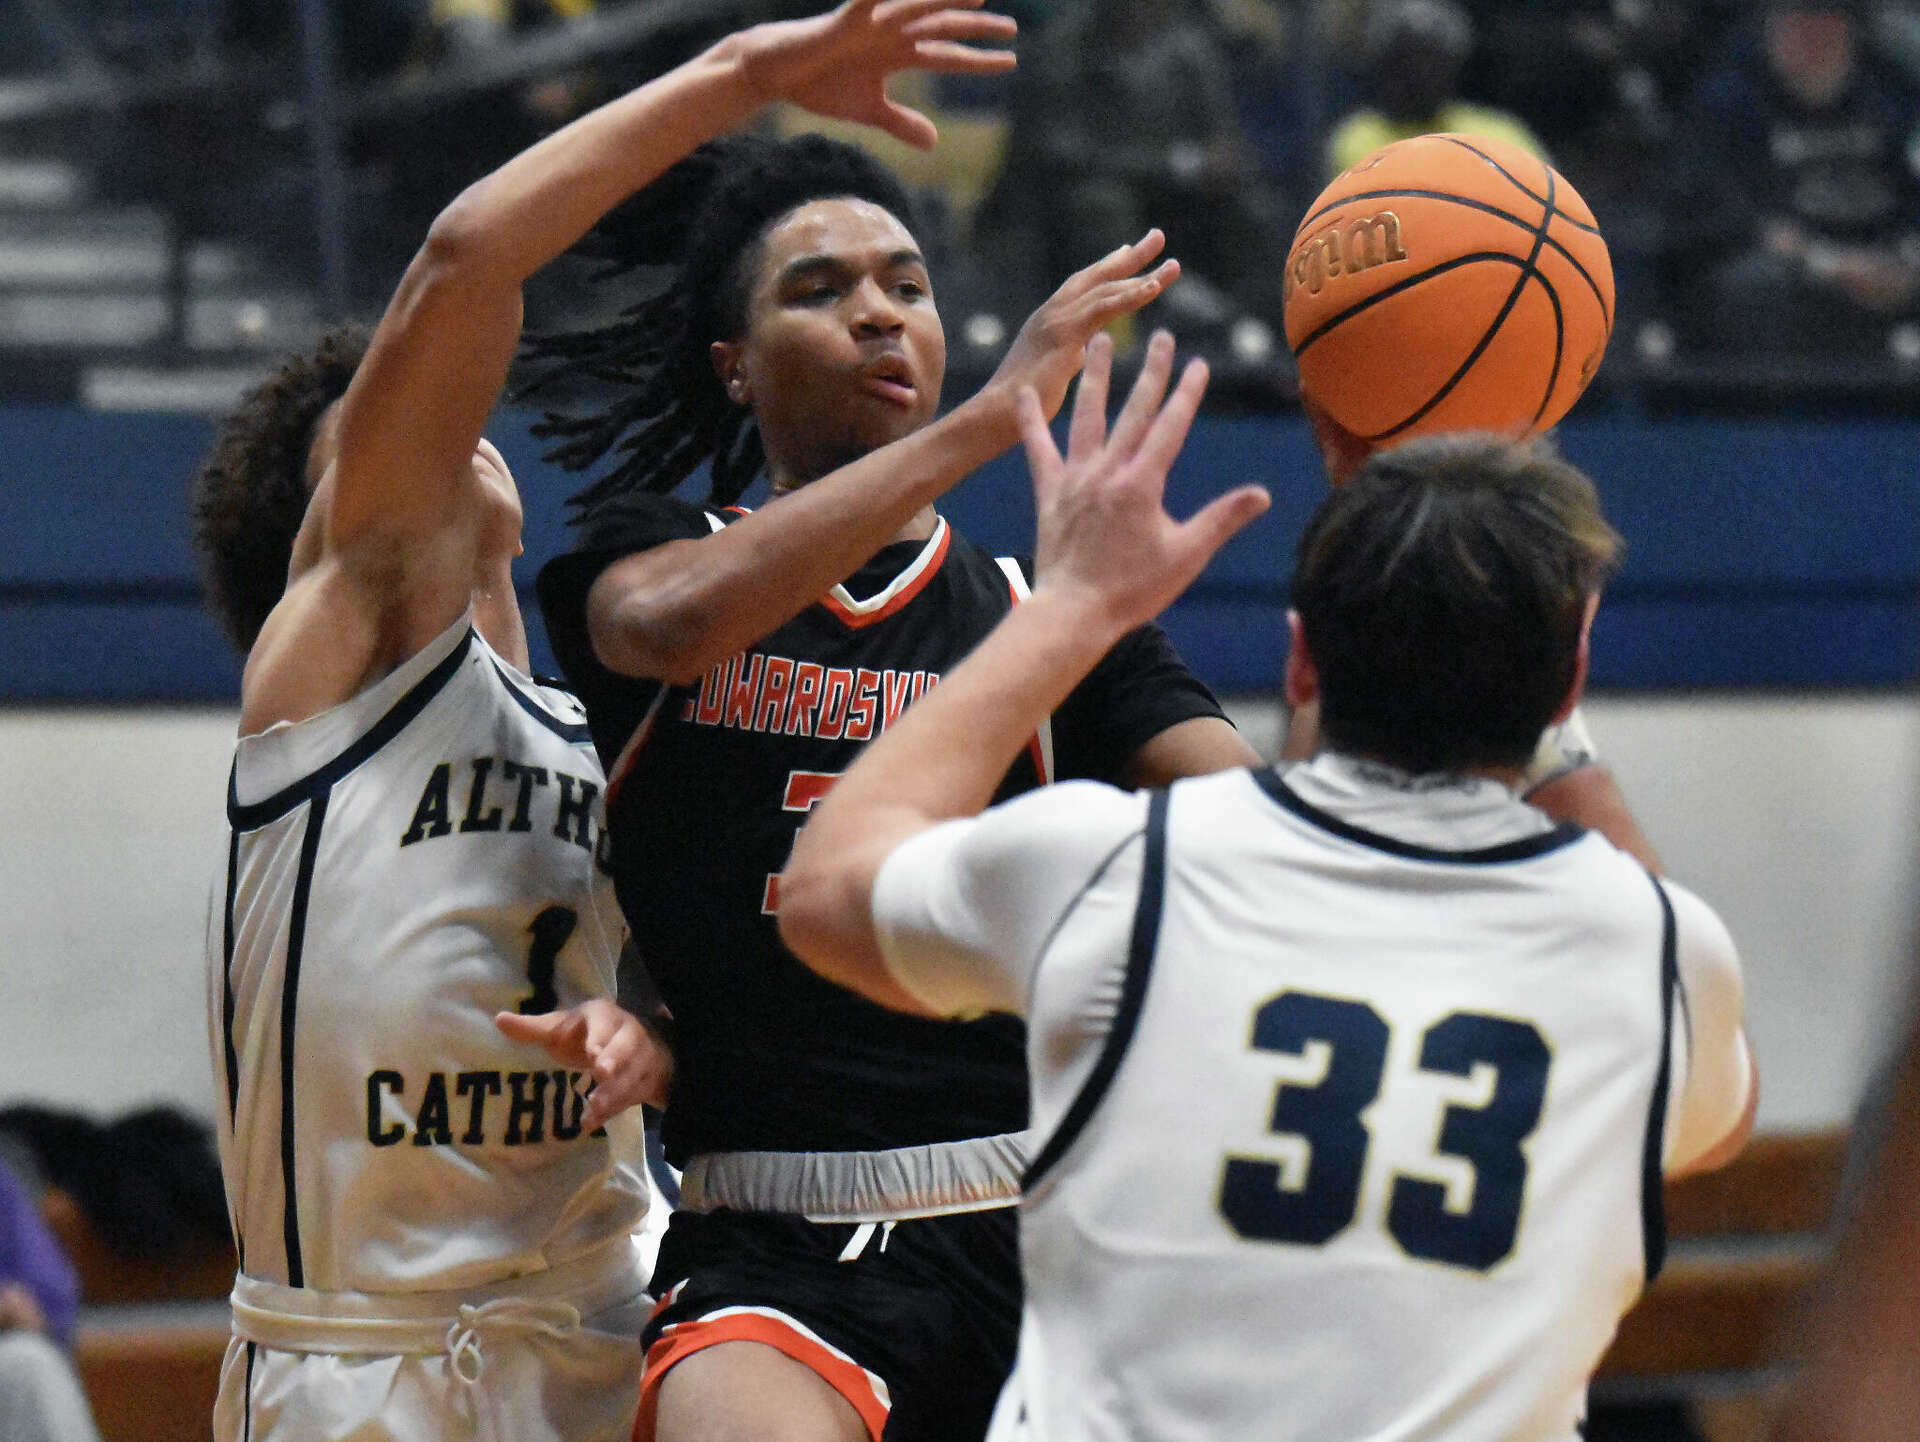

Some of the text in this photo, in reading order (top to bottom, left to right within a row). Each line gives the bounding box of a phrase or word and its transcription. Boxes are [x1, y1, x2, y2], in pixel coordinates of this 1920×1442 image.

[682, 652, 940, 741] DWARDSV
[519, 905, 578, 1016] 1
[367, 1068, 608, 1147] CATHO
[1214, 987, 1556, 1277] 33
